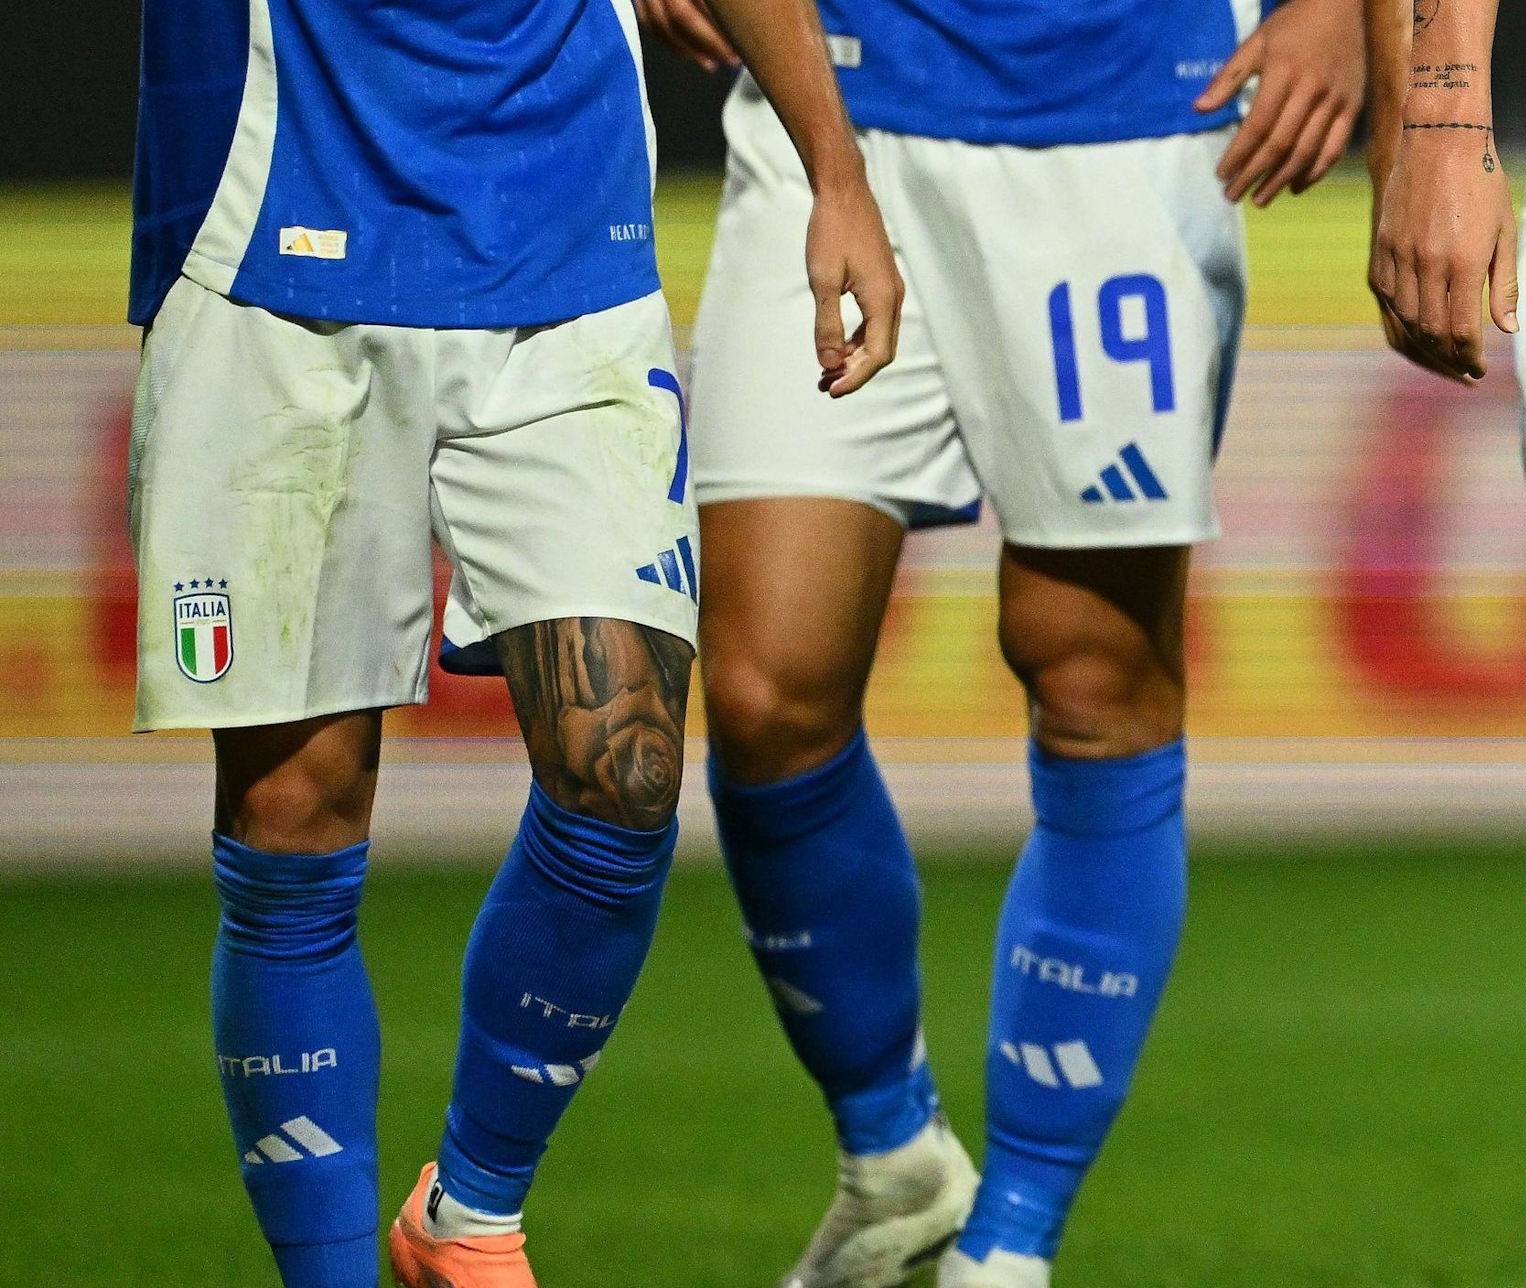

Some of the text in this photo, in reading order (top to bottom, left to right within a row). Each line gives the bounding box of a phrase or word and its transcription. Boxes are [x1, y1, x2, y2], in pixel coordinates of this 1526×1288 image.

[1444, 63, 1477, 72] breath
[1443, 81, 1470, 89] again
[1047, 273, 1176, 423] 19
[648, 367, 689, 504] 7
[179, 600, 227, 619] ITALIA
[1010, 945, 1139, 998] ITALIA
[217, 1048, 337, 1078] ITALIA
